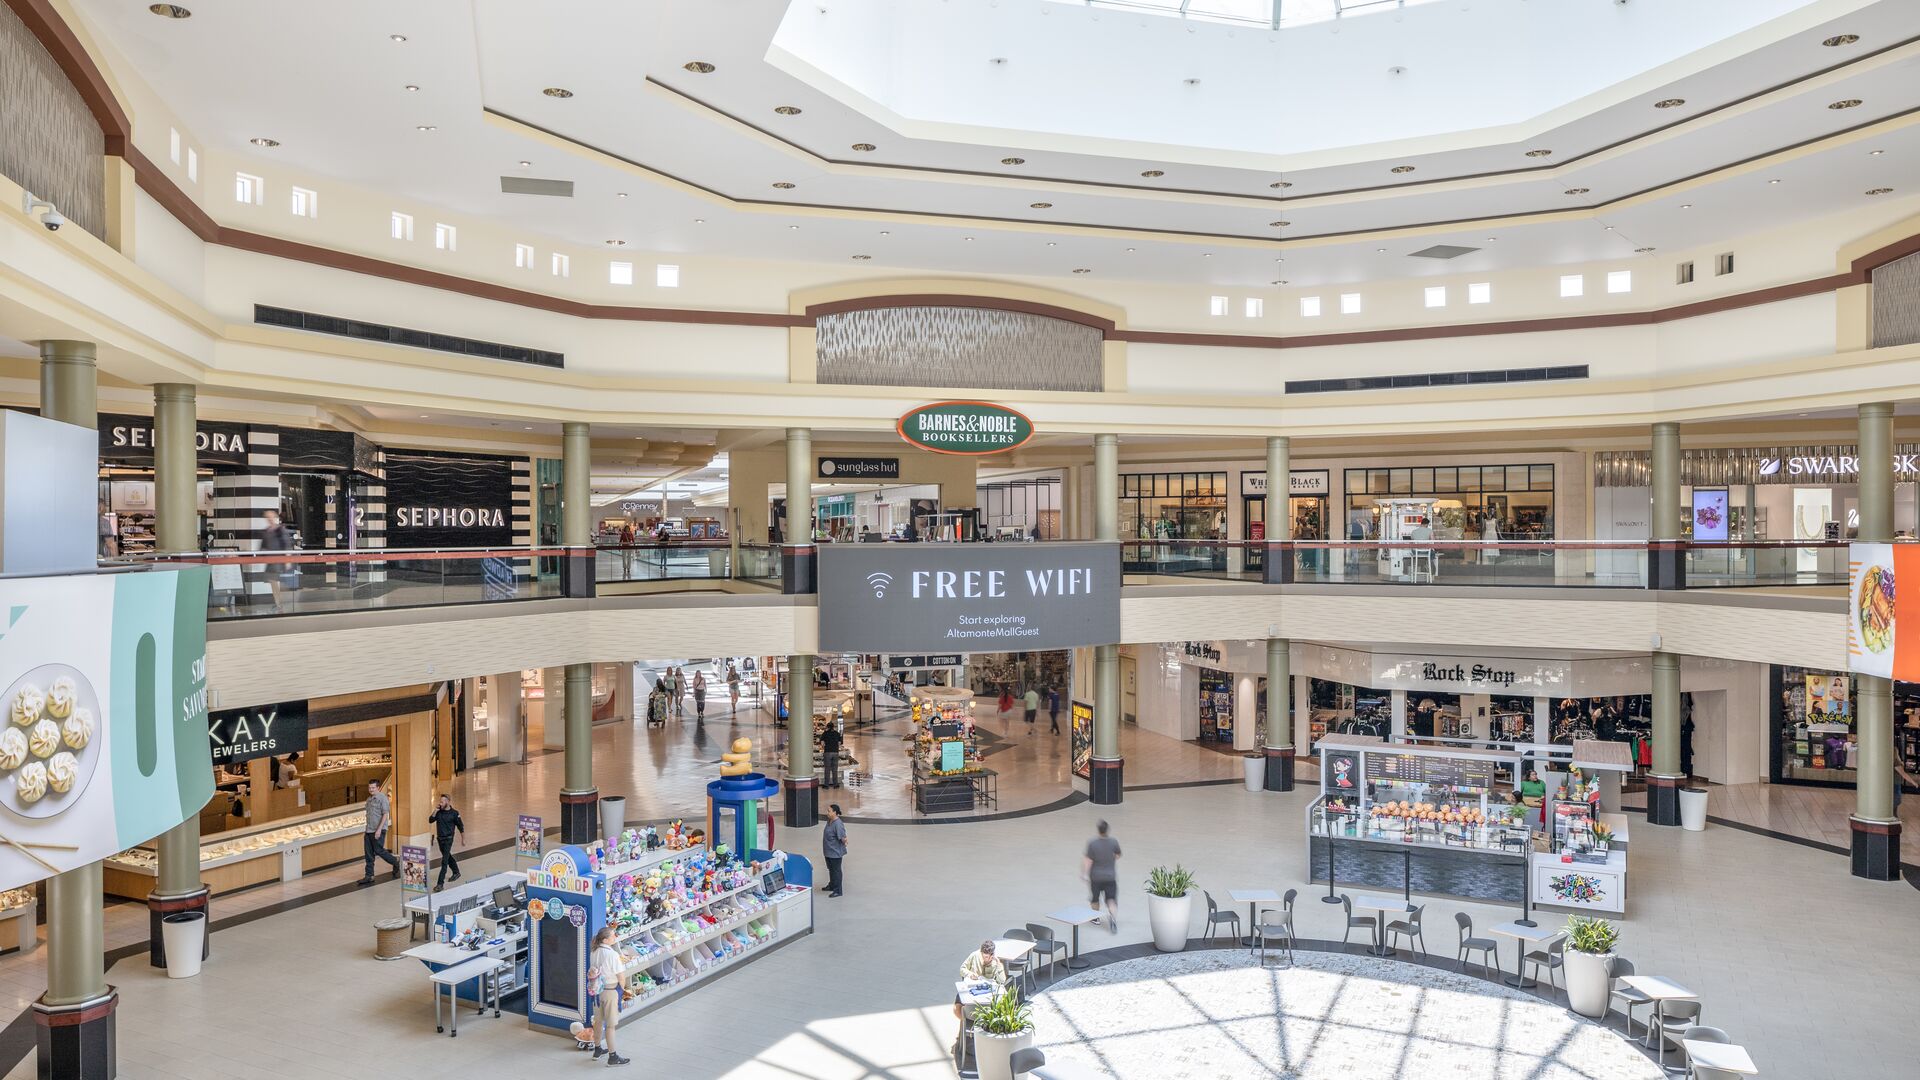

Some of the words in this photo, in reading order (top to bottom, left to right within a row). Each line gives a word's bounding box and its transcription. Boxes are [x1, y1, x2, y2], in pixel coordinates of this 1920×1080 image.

[112, 426, 246, 453] SEORA
[922, 432, 1015, 444] BOOKSELLERS
[837, 461, 879, 475] sunglass
[880, 461, 897, 473] hut
[1788, 454, 1920, 475] SWARSK
[1290, 477, 1321, 486] BLACK
[396, 506, 506, 528] SEPHORA
[911, 569, 1007, 599] FREE
[1025, 567, 1092, 598] WIFI
[959, 614, 982, 626] Start
[983, 613, 1027, 628] exploring
[1422, 662, 1465, 682] Rock
[1470, 663, 1516, 688] Stop
[208, 711, 277, 746] KAY
[212, 738, 277, 759] EWELERS
[528, 870, 590, 893] WORKSHOP
